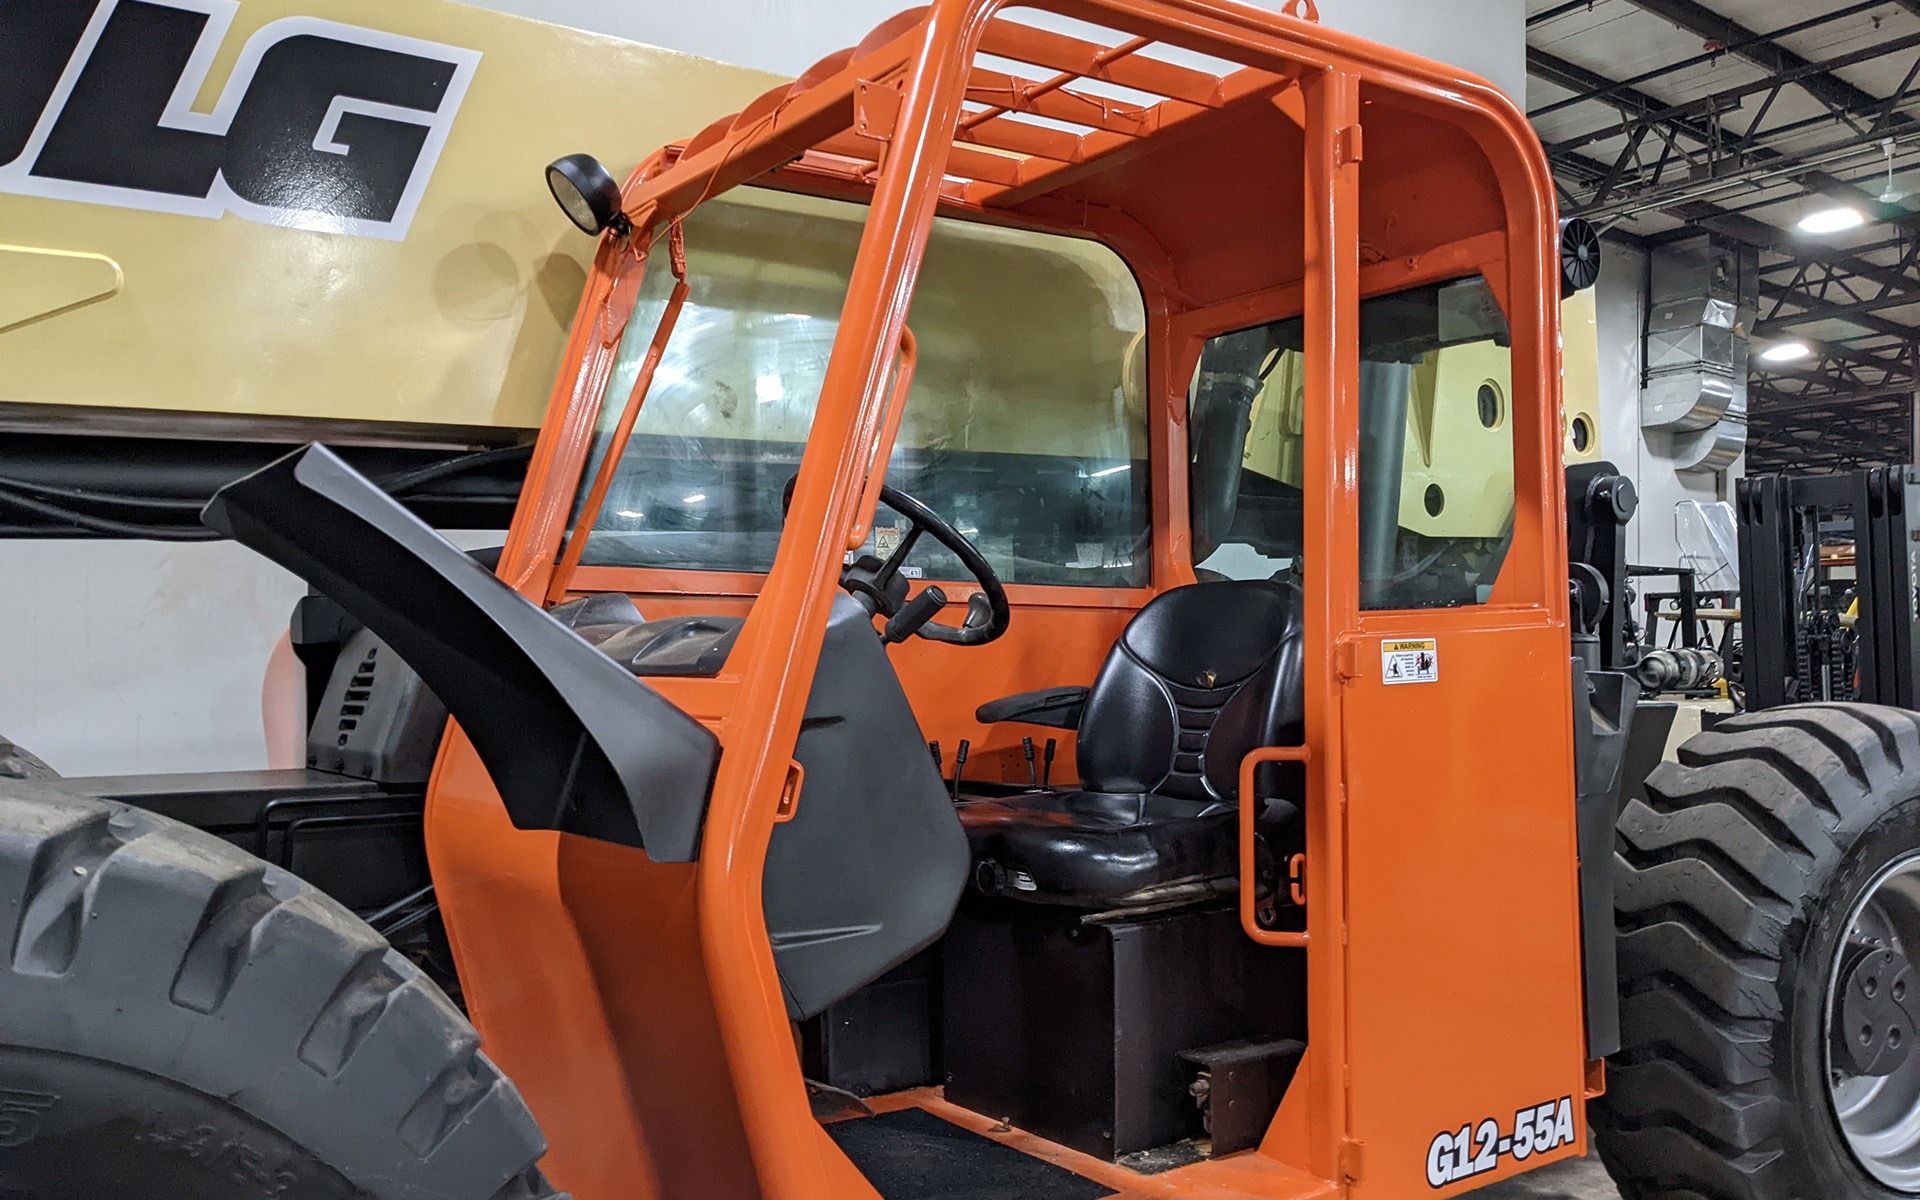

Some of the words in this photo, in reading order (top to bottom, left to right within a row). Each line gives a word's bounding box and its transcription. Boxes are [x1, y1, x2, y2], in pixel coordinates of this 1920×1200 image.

[1910, 550, 1919, 622] TOYOTA
[1400, 642, 1425, 650] WARNING
[1426, 1095, 1575, 1188] G12-55A
